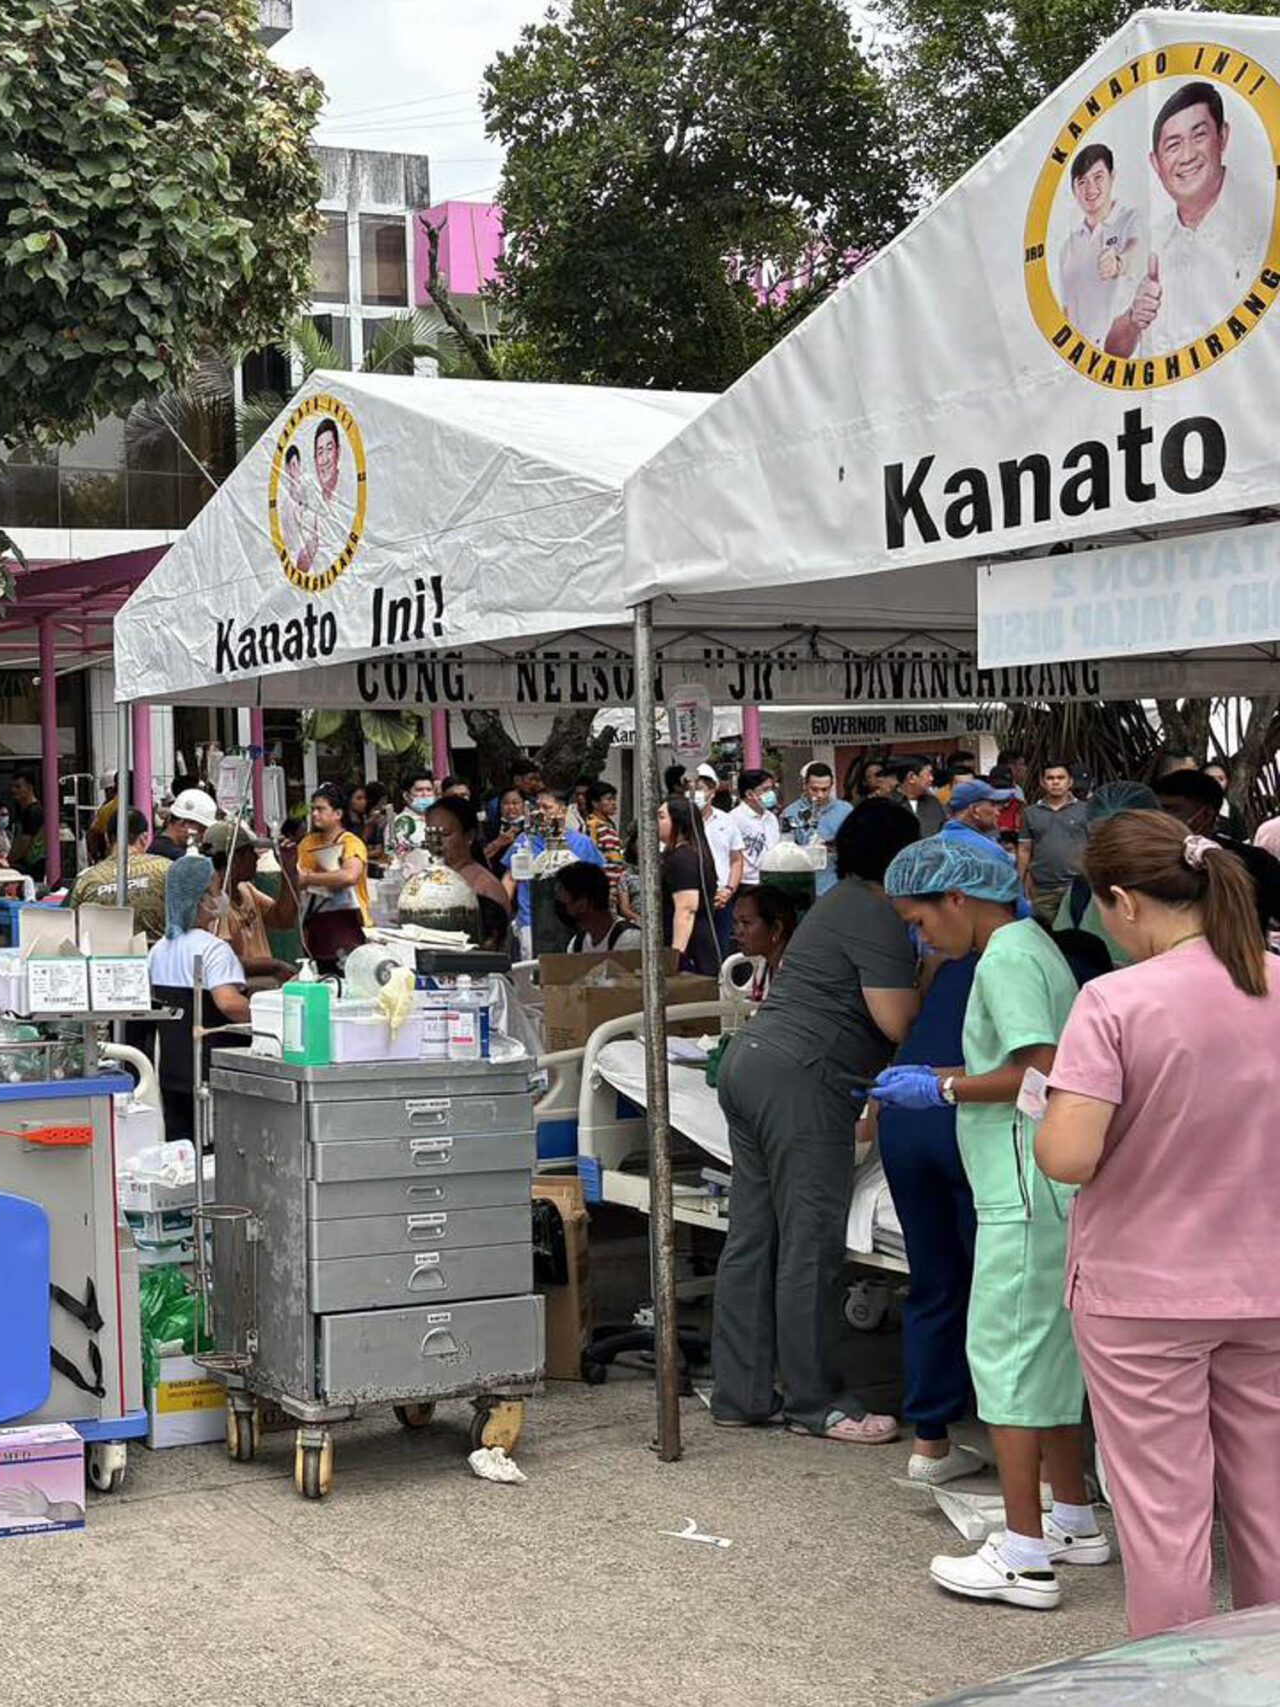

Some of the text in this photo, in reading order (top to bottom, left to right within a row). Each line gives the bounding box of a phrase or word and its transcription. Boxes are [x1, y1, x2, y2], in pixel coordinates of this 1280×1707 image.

[1050, 51, 1168, 165] KANATO
[1051, 267, 1280, 387] DAYANGHIRANG
[883, 406, 1227, 550] Kanato
[216, 575, 444, 674] Kanato Ini!
[356, 650, 476, 703] CONG.
[842, 650, 1101, 700] DAYANGHIRANG
[811, 714, 886, 736] GOVERNOR
[894, 712, 948, 734] NELSON
